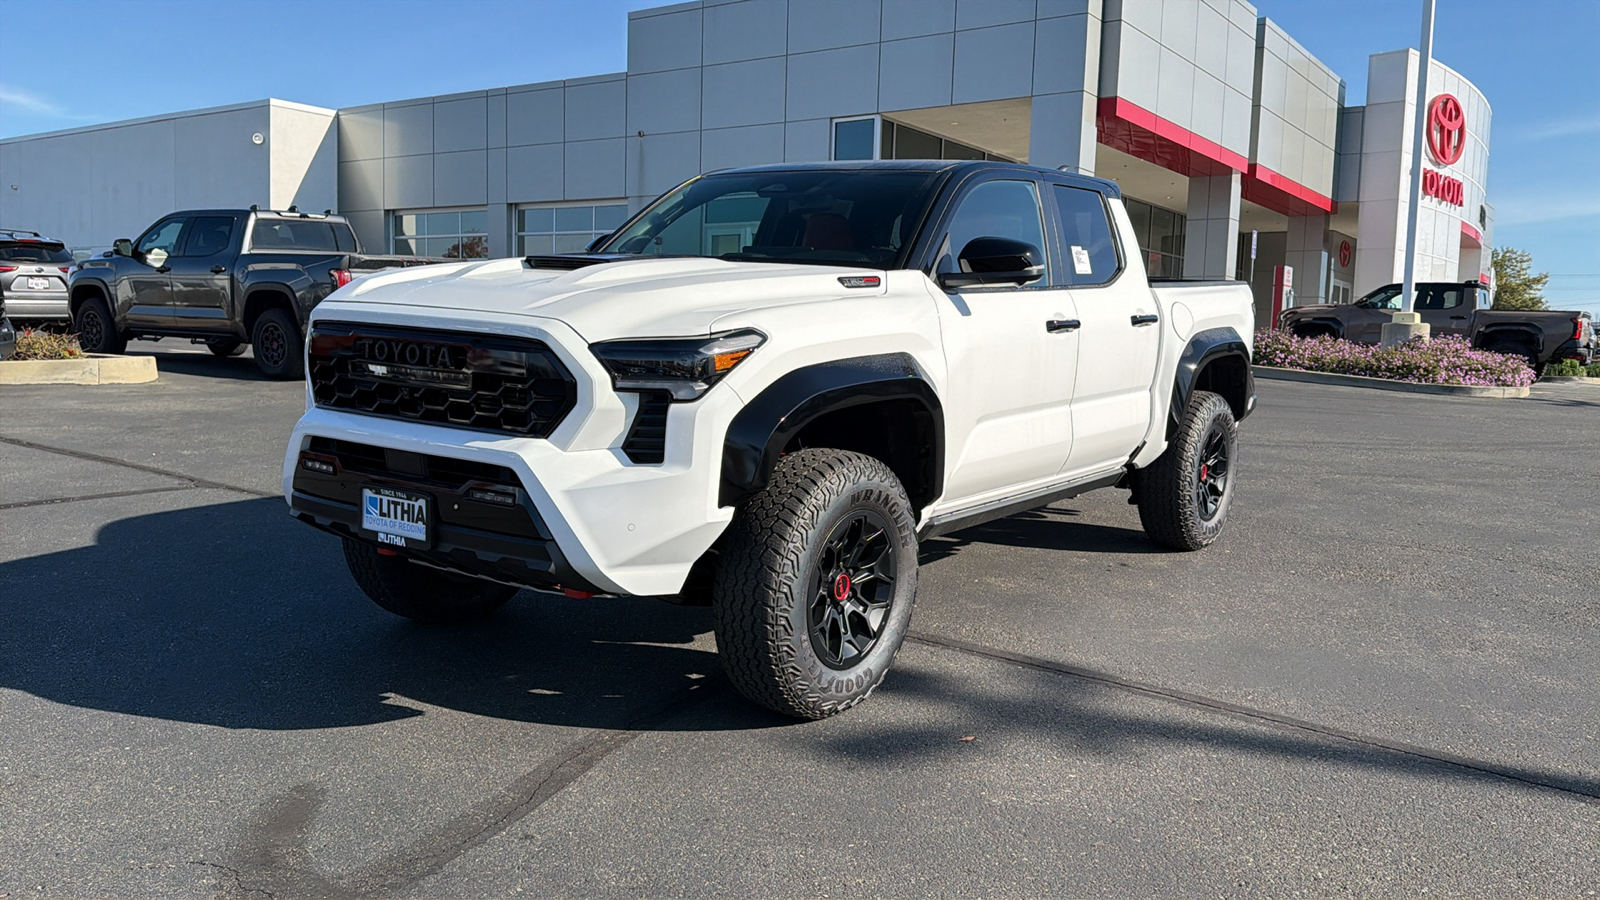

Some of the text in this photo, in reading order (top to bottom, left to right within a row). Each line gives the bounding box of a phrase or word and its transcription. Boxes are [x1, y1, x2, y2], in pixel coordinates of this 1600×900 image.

[360, 339, 452, 368] TOYOTA
[380, 488, 395, 497] SINCE
[365, 515, 388, 528] TOYOTA
[389, 520, 398, 529] OF
[378, 497, 427, 526] LITHIA
[849, 488, 912, 549] WRANGLER
[384, 532, 406, 547] LITHIA
